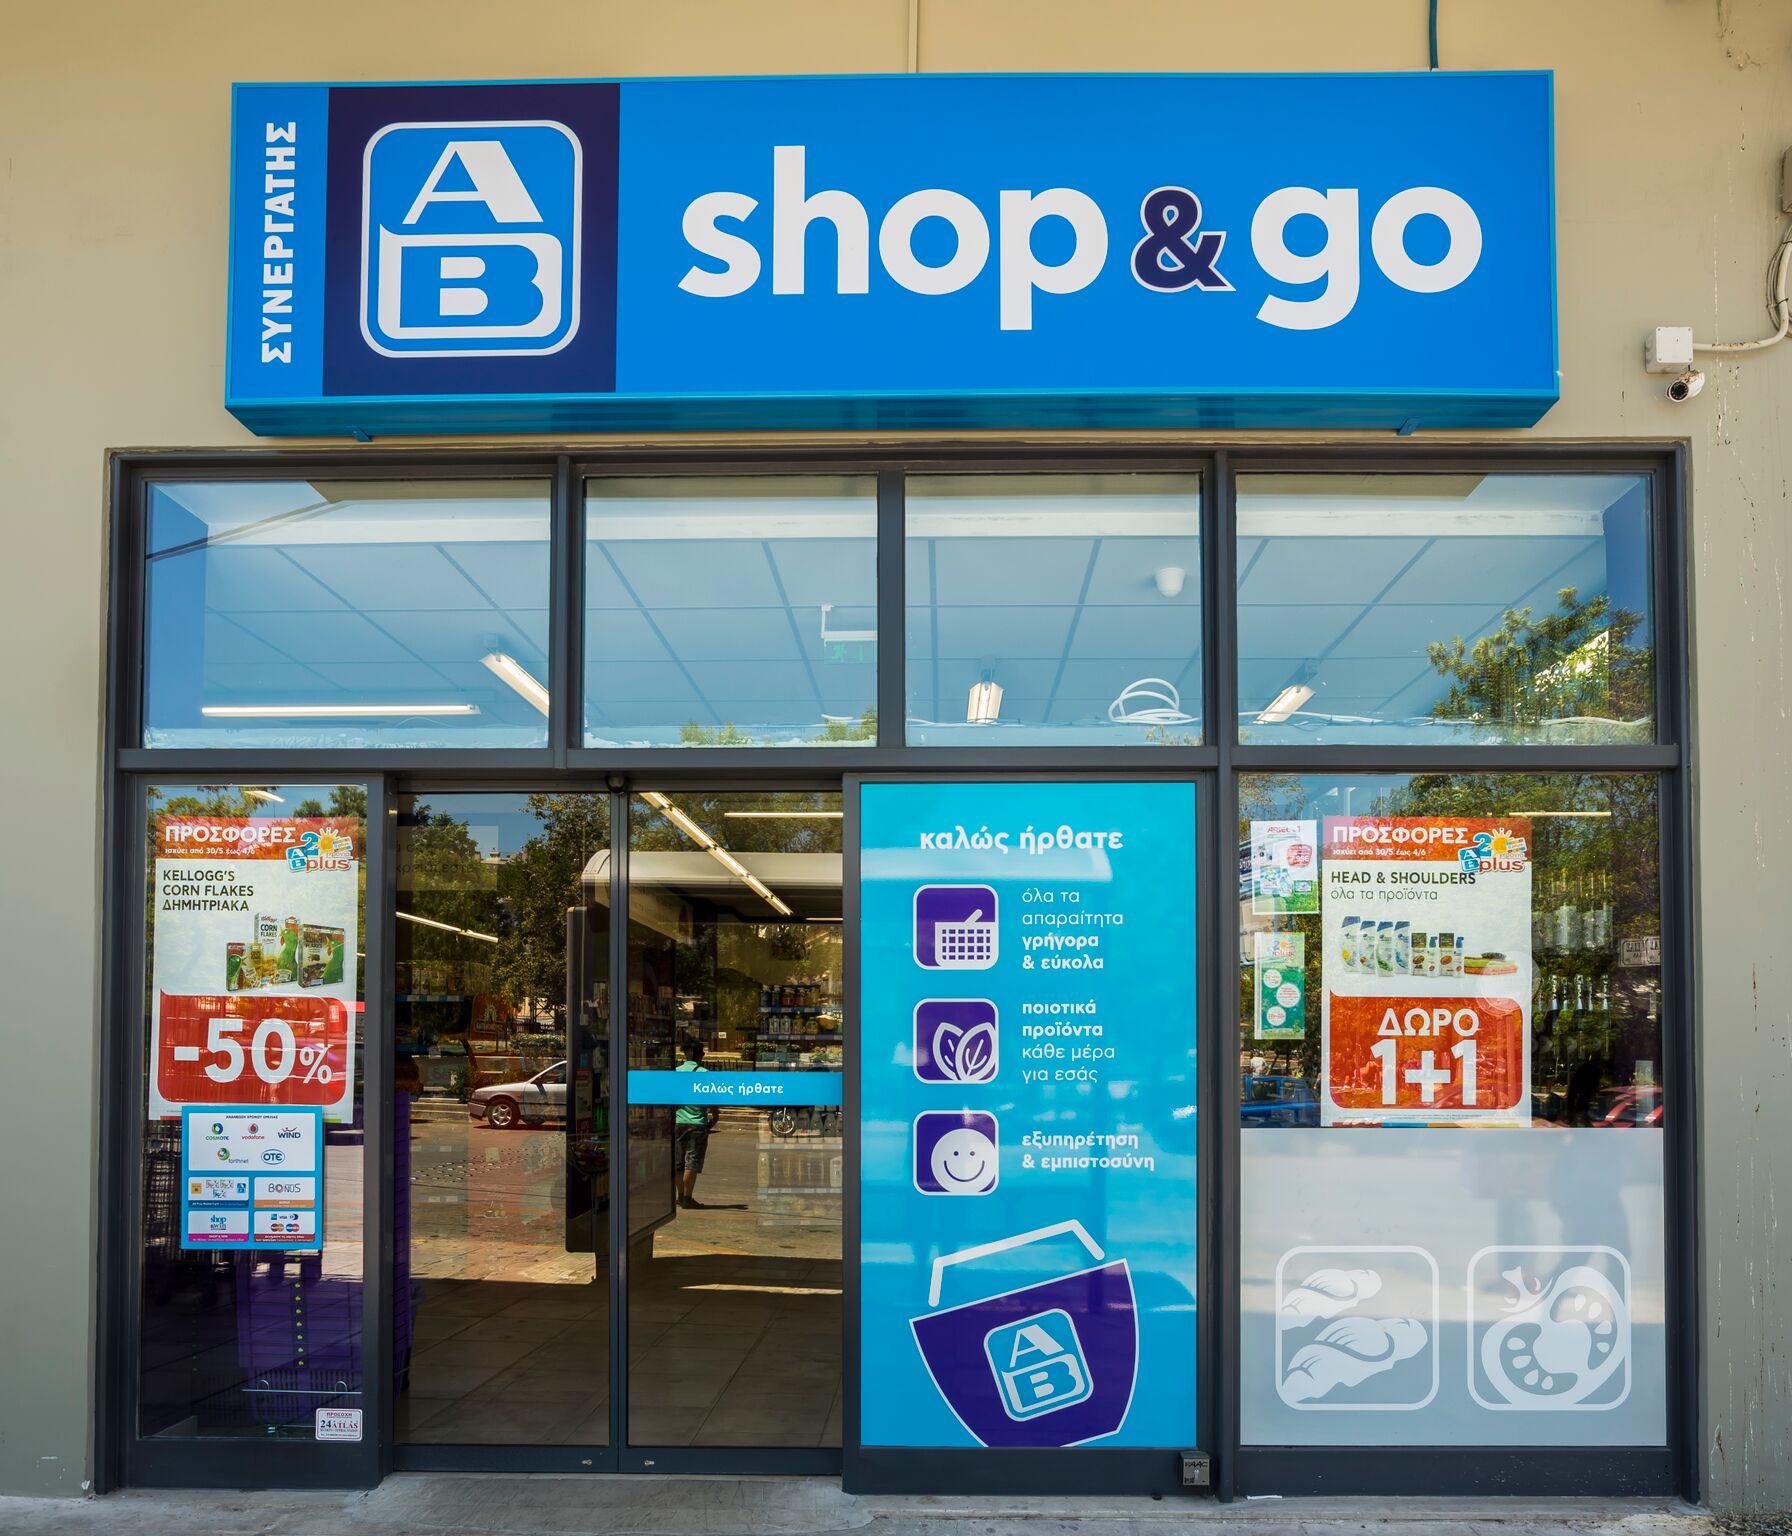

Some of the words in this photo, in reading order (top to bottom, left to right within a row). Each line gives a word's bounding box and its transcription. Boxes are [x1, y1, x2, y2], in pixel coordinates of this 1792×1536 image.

[261, 121, 296, 363] ΣΥΝΕΡΓΑΤΗΣ
[677, 145, 1108, 330] shop
[1131, 186, 1236, 292] &
[1251, 186, 1483, 330] go
[165, 825, 296, 843] ΠΡΟΣΦΟΡΕΣ
[920, 825, 1010, 854] καλώς
[1020, 825, 1123, 854] ήρθατε
[1333, 826, 1468, 844] ΠΡΟΣΦΟΡΕΣ
[189, 846, 205, 856] από
[206, 847, 223, 855] 30/5
[1333, 848, 1356, 857] ισχύει
[1358, 848, 1373, 857] από
[1375, 848, 1394, 856] 30/5
[1396, 848, 1411, 857] έως
[1413, 848, 1426, 856] 4/6
[306, 856, 350, 871] plus
[1479, 857, 1524, 872] plus
[163, 870, 235, 881] KELLOGG'S
[1331, 872, 1371, 883] HEAD
[1377, 872, 1386, 884] &
[1390, 872, 1476, 885] SHOULDERS
[162, 885, 201, 896] CORN
[205, 885, 254, 896] FLAKES
[1022, 888, 1054, 903] όλα
[1061, 890, 1080, 903] τα
[1331, 886, 1354, 900] όλα
[1360, 889, 1374, 900] τα
[1379, 887, 1438, 903] προϊόντα
[162, 899, 249, 911] ΔΗΜΗΤΡΙΑΚΑ
[1022, 910, 1124, 928] απαραίτητα
[1022, 932, 1099, 950] γρήγορα
[1022, 955, 1035, 969] &
[1041, 953, 1104, 969] εύκολα
[1022, 999, 1096, 1014] ποιοτικά
[1022, 1021, 1103, 1039] προϊόντα
[1377, 1008, 1480, 1037] ΔΩΡΟ
[174, 1018, 333, 1084] -50%
[1022, 1043, 1065, 1059] κάθε
[1071, 1043, 1115, 1062] μέρα
[1022, 1069, 1048, 1083] για
[1054, 1065, 1098, 1084] εσάς
[1370, 1039, 1477, 1105] 1+1
[693, 1082, 734, 1095] Καλώς
[738, 1082, 784, 1096] ήρθατε
[278, 1131, 301, 1139] WIND
[1022, 1131, 1139, 1149] εξυπηρέτηση
[1022, 1155, 1035, 1168] &
[1041, 1153, 1155, 1172] εμπιστοσύνη
